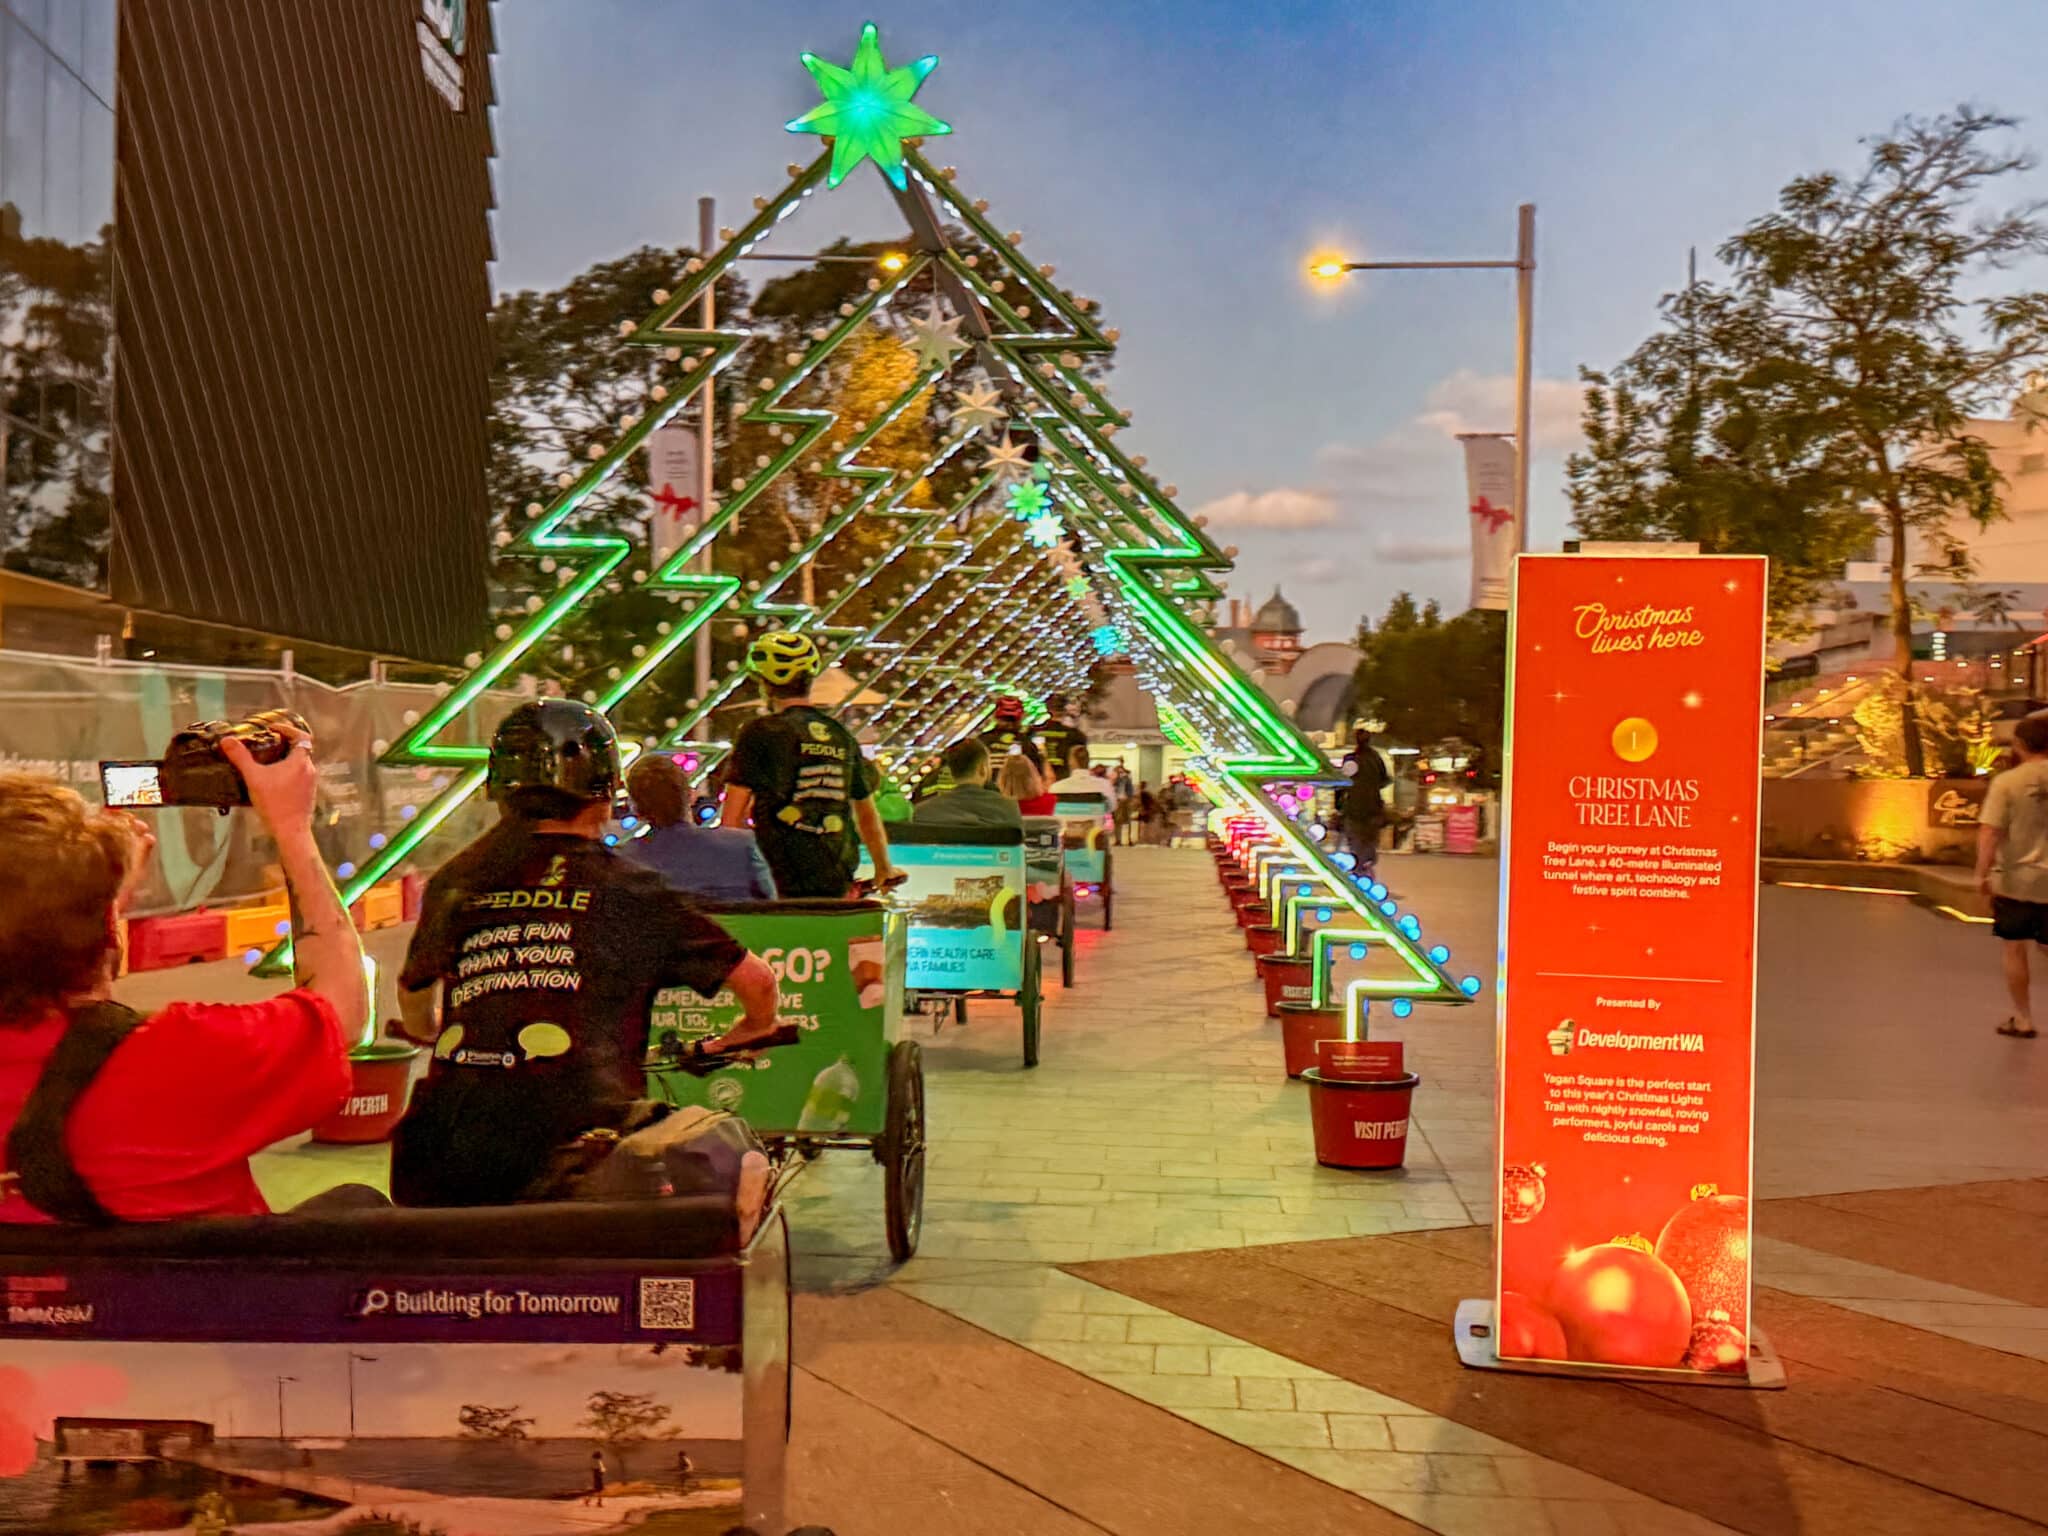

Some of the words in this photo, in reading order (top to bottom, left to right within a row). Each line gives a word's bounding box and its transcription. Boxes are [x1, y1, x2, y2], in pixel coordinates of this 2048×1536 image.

[1573, 602, 1694, 638] Christmas
[1591, 630, 1645, 653] lives
[1648, 626, 1704, 649] here
[800, 743, 846, 760] PEDDLE
[1569, 776, 1700, 801] CHRISTMAS
[1575, 803, 1630, 826] TREE
[1635, 804, 1692, 828] LANE
[1547, 841, 1579, 855] Begin
[1581, 844, 1606, 856] your
[1607, 844, 1649, 857] journey
[1650, 846, 1660, 856] at
[1662, 845, 1718, 857] Christmas
[1543, 855, 1566, 867] Tree
[1599, 859, 1607, 868] a
[1608, 857, 1659, 870] 40-metre
[1662, 859, 1722, 872] illuminated
[1543, 871, 1578, 880] tunnel
[1580, 871, 1614, 882] where
[1635, 873, 1697, 887] technology
[1699, 876, 1720, 885] and
[468, 890, 592, 912] EDDLE
[1573, 884, 1608, 896] festive
[1610, 887, 1637, 898] spirit
[1639, 888, 1690, 899] combine.
[463, 925, 522, 952] MORE
[524, 922, 573, 942] FUN
[457, 950, 510, 978] THAN
[515, 946, 575, 966] YOUR
[762, 947, 832, 983] GO?
[451, 969, 582, 1008] DESTINATION
[654, 990, 735, 1008] EMEMER
[1596, 996, 1646, 1009] Presented
[1648, 998, 1661, 1010] By
[1578, 1029, 1704, 1052] DevelopmentWA
[1543, 1072, 1576, 1086] Yagan
[1577, 1075, 1614, 1087] Square
[1616, 1077, 1625, 1087] is
[1627, 1077, 1645, 1088] the
[1646, 1079, 1685, 1091] perfect
[1687, 1081, 1711, 1092] start
[351, 1094, 388, 1116] PERTH
[1550, 1088, 1561, 1098] to
[1563, 1088, 1582, 1099] this
[1583, 1090, 1614, 1101] year's
[1616, 1090, 1669, 1103] Christmas
[1671, 1093, 1703, 1106] Lights
[1543, 1101, 1566, 1112] Trail
[1567, 1102, 1589, 1112] with
[1591, 1104, 1627, 1117] nightly
[1629, 1107, 1674, 1118] snowfall,
[1676, 1110, 1710, 1122] roving
[1354, 1120, 1383, 1140] VISIT
[1552, 1116, 1612, 1129] performers,
[1613, 1120, 1643, 1131] joyful
[1645, 1121, 1677, 1132] carols
[1678, 1123, 1699, 1134] and
[1583, 1132, 1630, 1143] delicious
[396, 1290, 482, 1318] Building
[484, 1289, 515, 1314] for
[515, 1291, 620, 1314] Tomorrow
